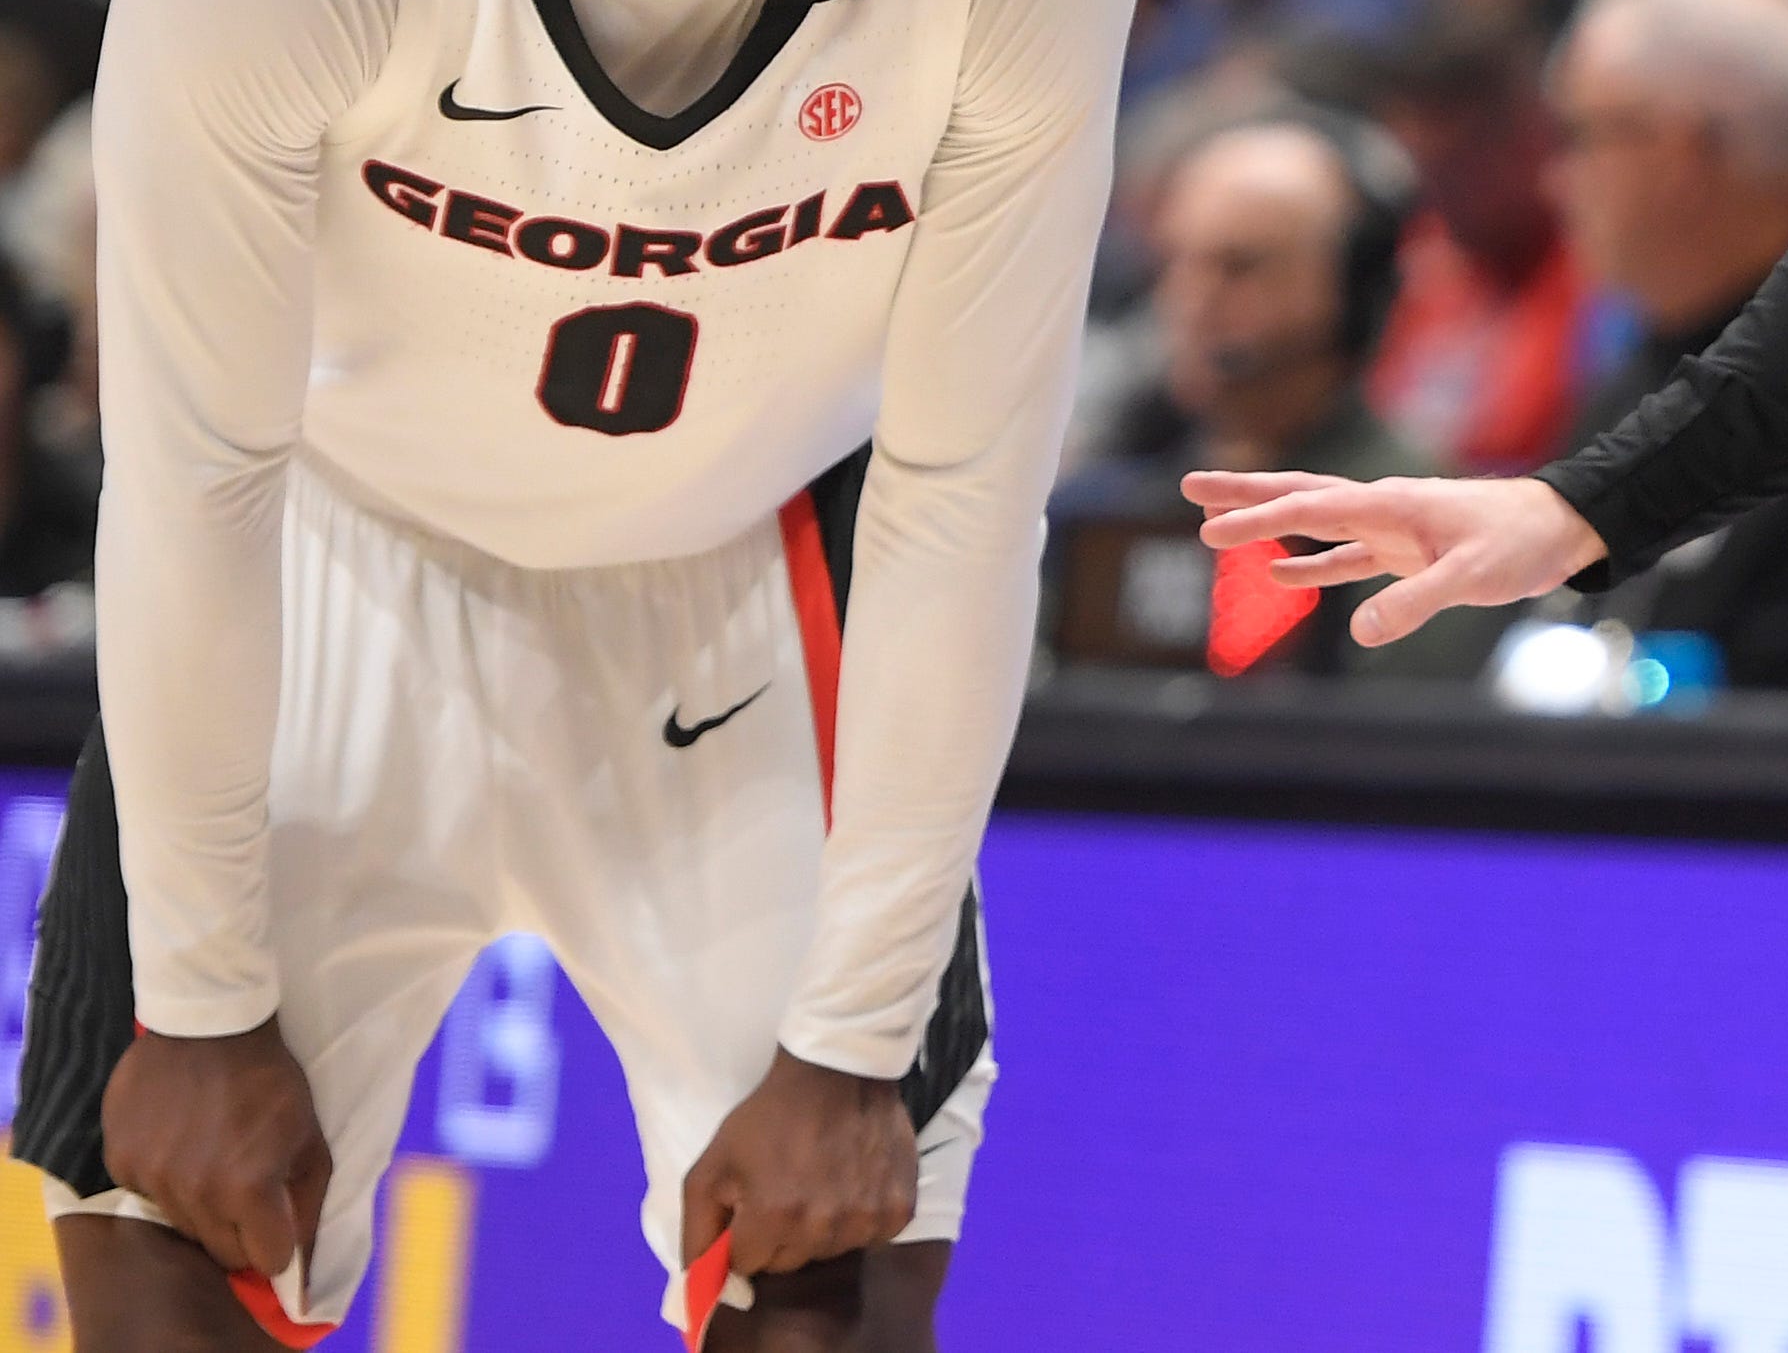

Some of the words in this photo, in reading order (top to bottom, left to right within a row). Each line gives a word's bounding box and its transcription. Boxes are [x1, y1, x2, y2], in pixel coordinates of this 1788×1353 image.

[804, 89, 855, 137] SEC
[361, 158, 916, 278] GEORGIA
[535, 300, 699, 436] 0
